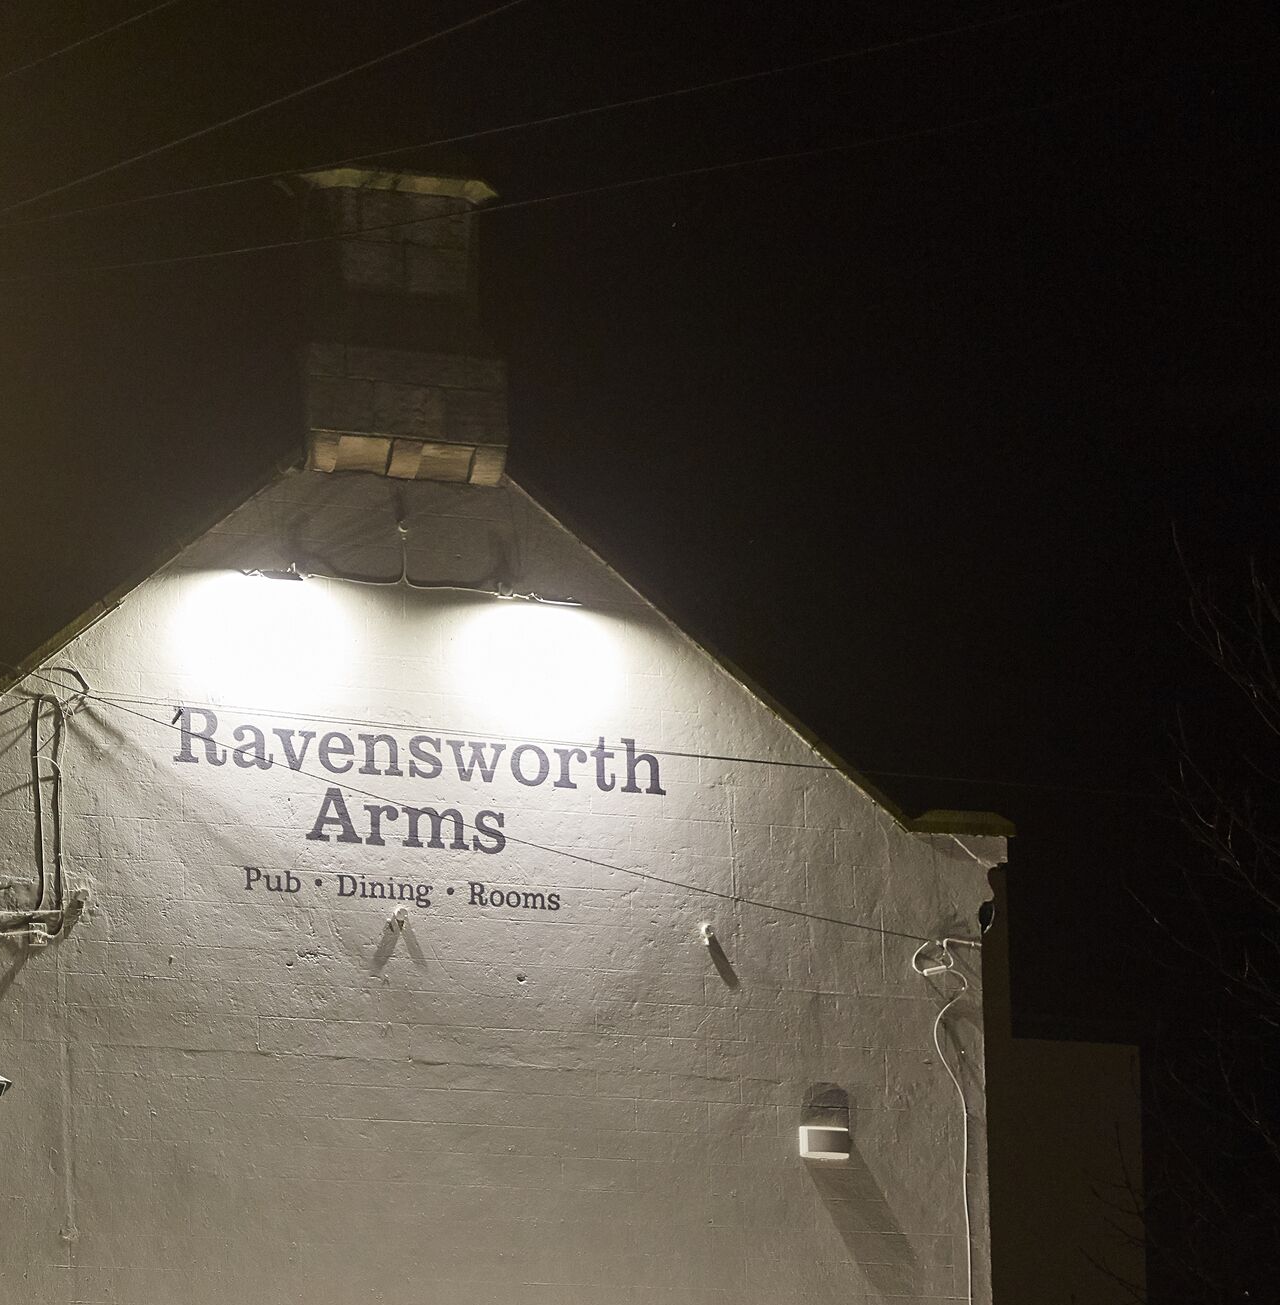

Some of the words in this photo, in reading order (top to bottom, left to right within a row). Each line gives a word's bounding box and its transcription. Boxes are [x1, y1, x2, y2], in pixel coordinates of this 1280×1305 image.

[173, 705, 667, 797] Ravensworth
[306, 787, 507, 855] Arms
[244, 866, 302, 894] Pub
[337, 874, 433, 909] Dining
[467, 881, 561, 912] Rooms
